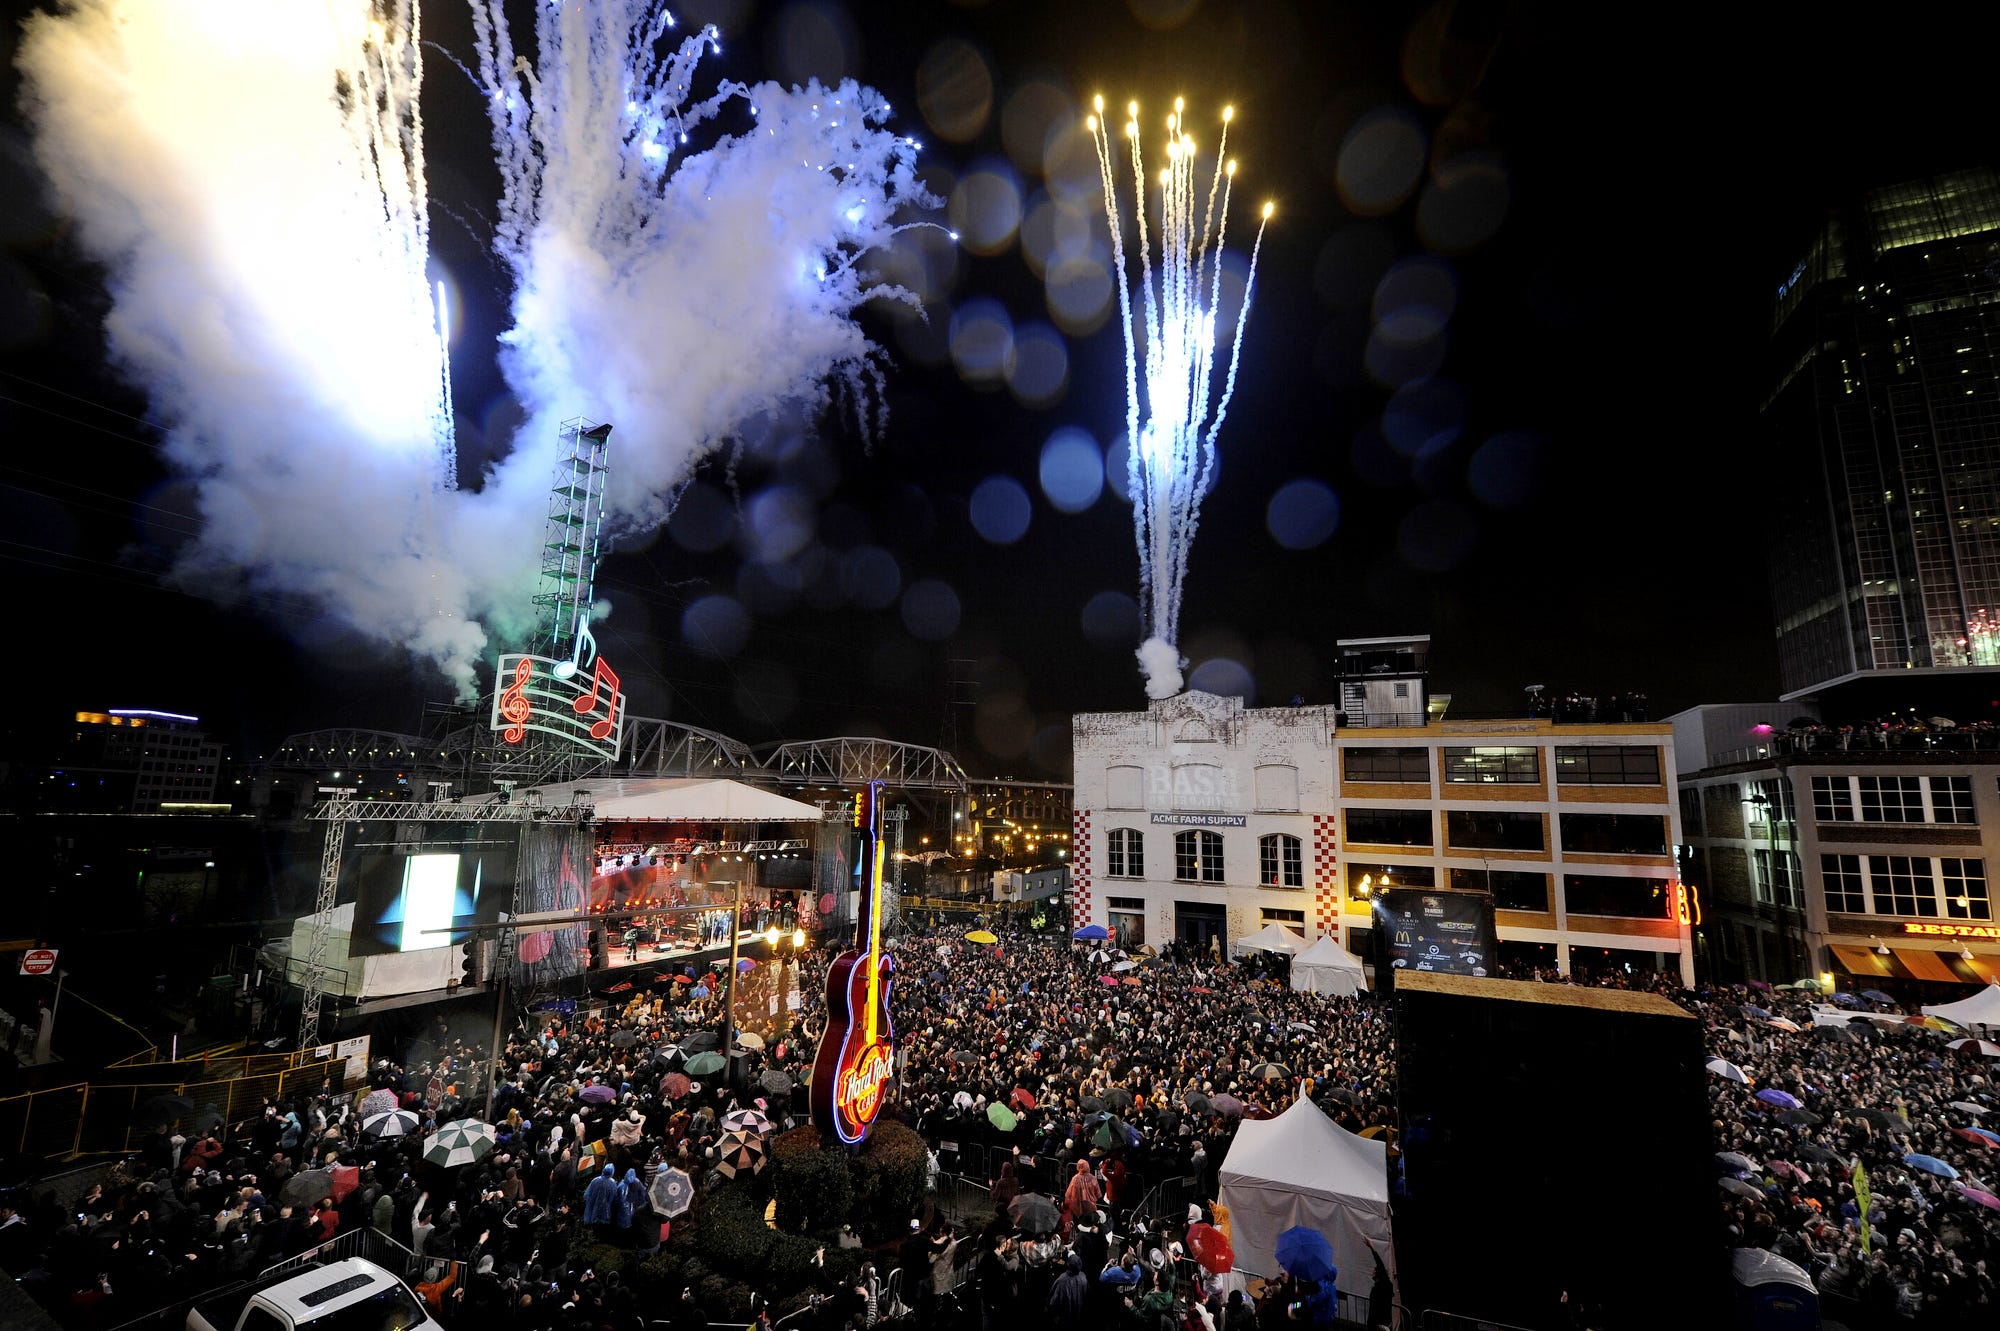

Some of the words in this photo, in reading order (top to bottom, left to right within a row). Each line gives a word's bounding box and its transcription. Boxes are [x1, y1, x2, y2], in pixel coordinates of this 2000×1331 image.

[1152, 815, 1179, 823] ACME
[1180, 815, 1206, 824] FARM
[1207, 816, 1245, 826] SUPPLY
[846, 1063, 873, 1104] Hard
[873, 1050, 895, 1086] Rock
[427, 1086, 441, 1101] STOP
